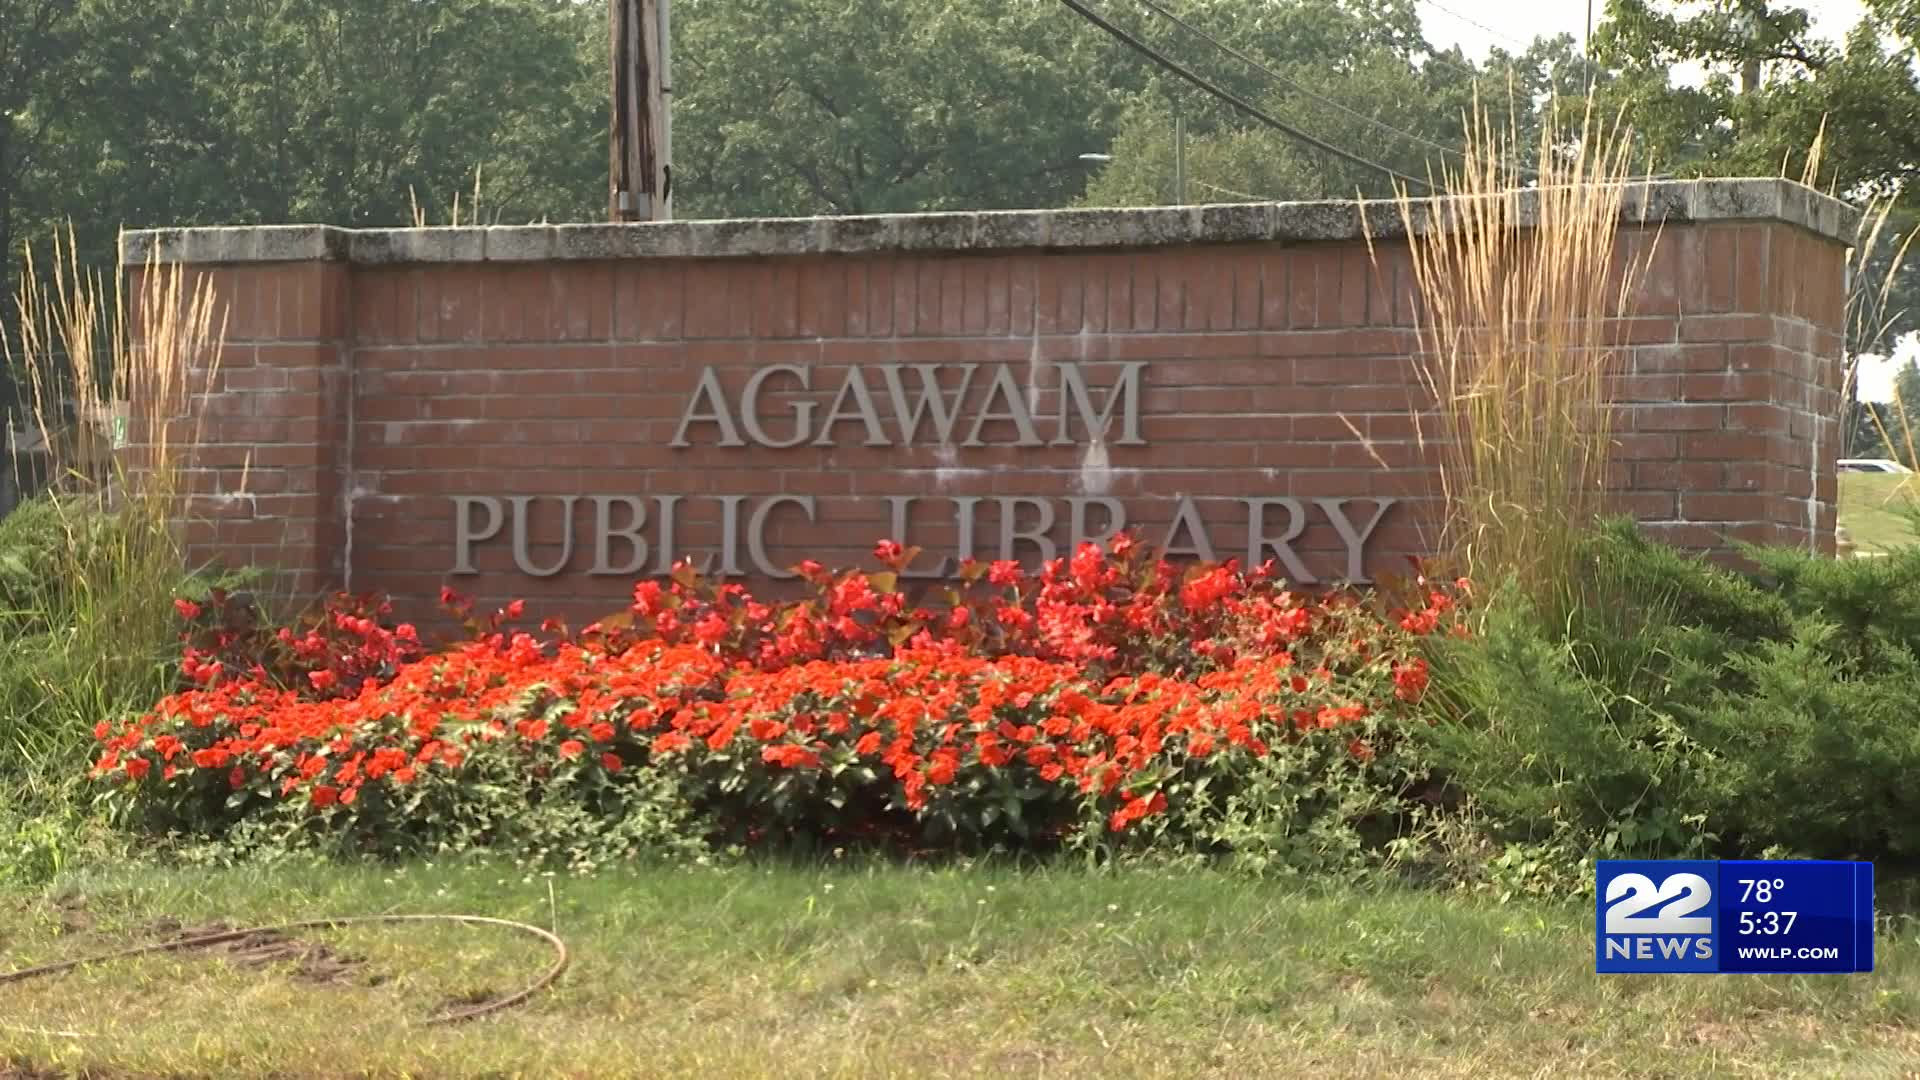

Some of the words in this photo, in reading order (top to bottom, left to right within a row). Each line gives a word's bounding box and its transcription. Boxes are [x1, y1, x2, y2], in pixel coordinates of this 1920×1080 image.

[668, 361, 1147, 448] AGAWAM
[449, 494, 816, 578] PUBLIC
[886, 494, 1397, 585] LIBRARY
